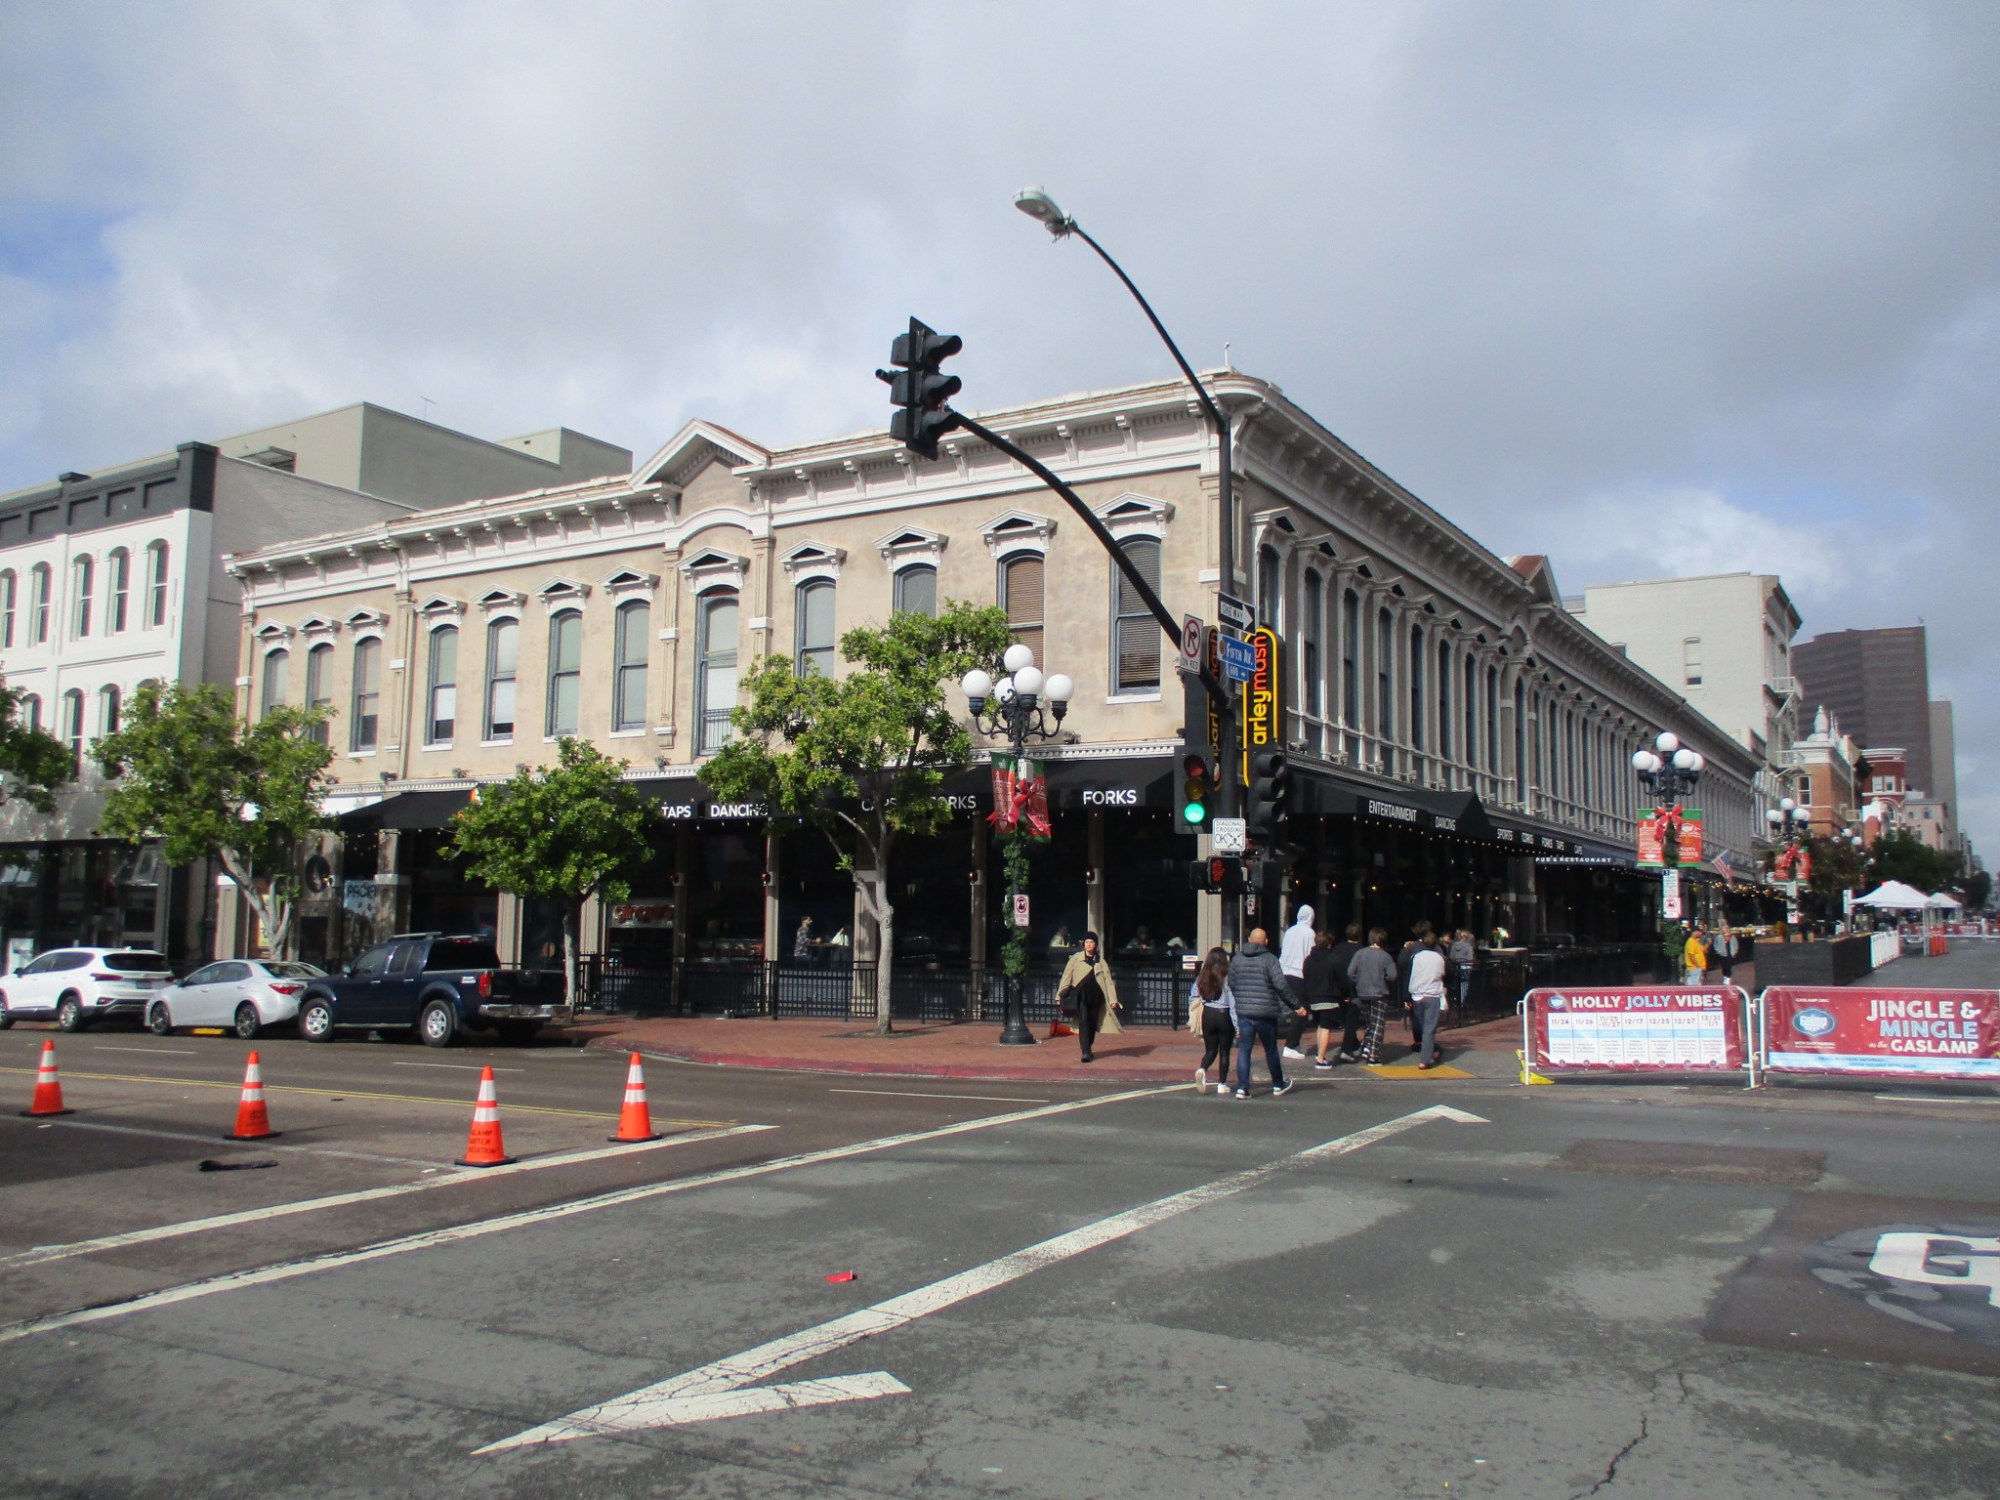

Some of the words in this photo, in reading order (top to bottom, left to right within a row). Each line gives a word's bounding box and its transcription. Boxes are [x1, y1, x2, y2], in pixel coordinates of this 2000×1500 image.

[1222, 603, 1232, 617] ONE
[1232, 607, 1243, 620] WAY
[1190, 659, 1199, 670] RED
[1249, 635, 1272, 745] arleymash
[930, 795, 977, 810] RKS
[1083, 789, 1137, 805] FORKS
[661, 804, 692, 818] TAPS
[1368, 800, 1417, 822] ENTERTAINMENT
[1434, 816, 1456, 831] DANCING
[1215, 833, 1228, 844] OK
[1571, 995, 1621, 1008] HOLLY
[1624, 994, 1671, 1010] JOLLY
[1675, 994, 1723, 1007] VIBES
[1866, 999, 1955, 1021] JINGLE
[1960, 1001, 1982, 1019] &
[1880, 1020, 1979, 1039] MINGLE
[1890, 1039, 1979, 1054] GASLAMP
